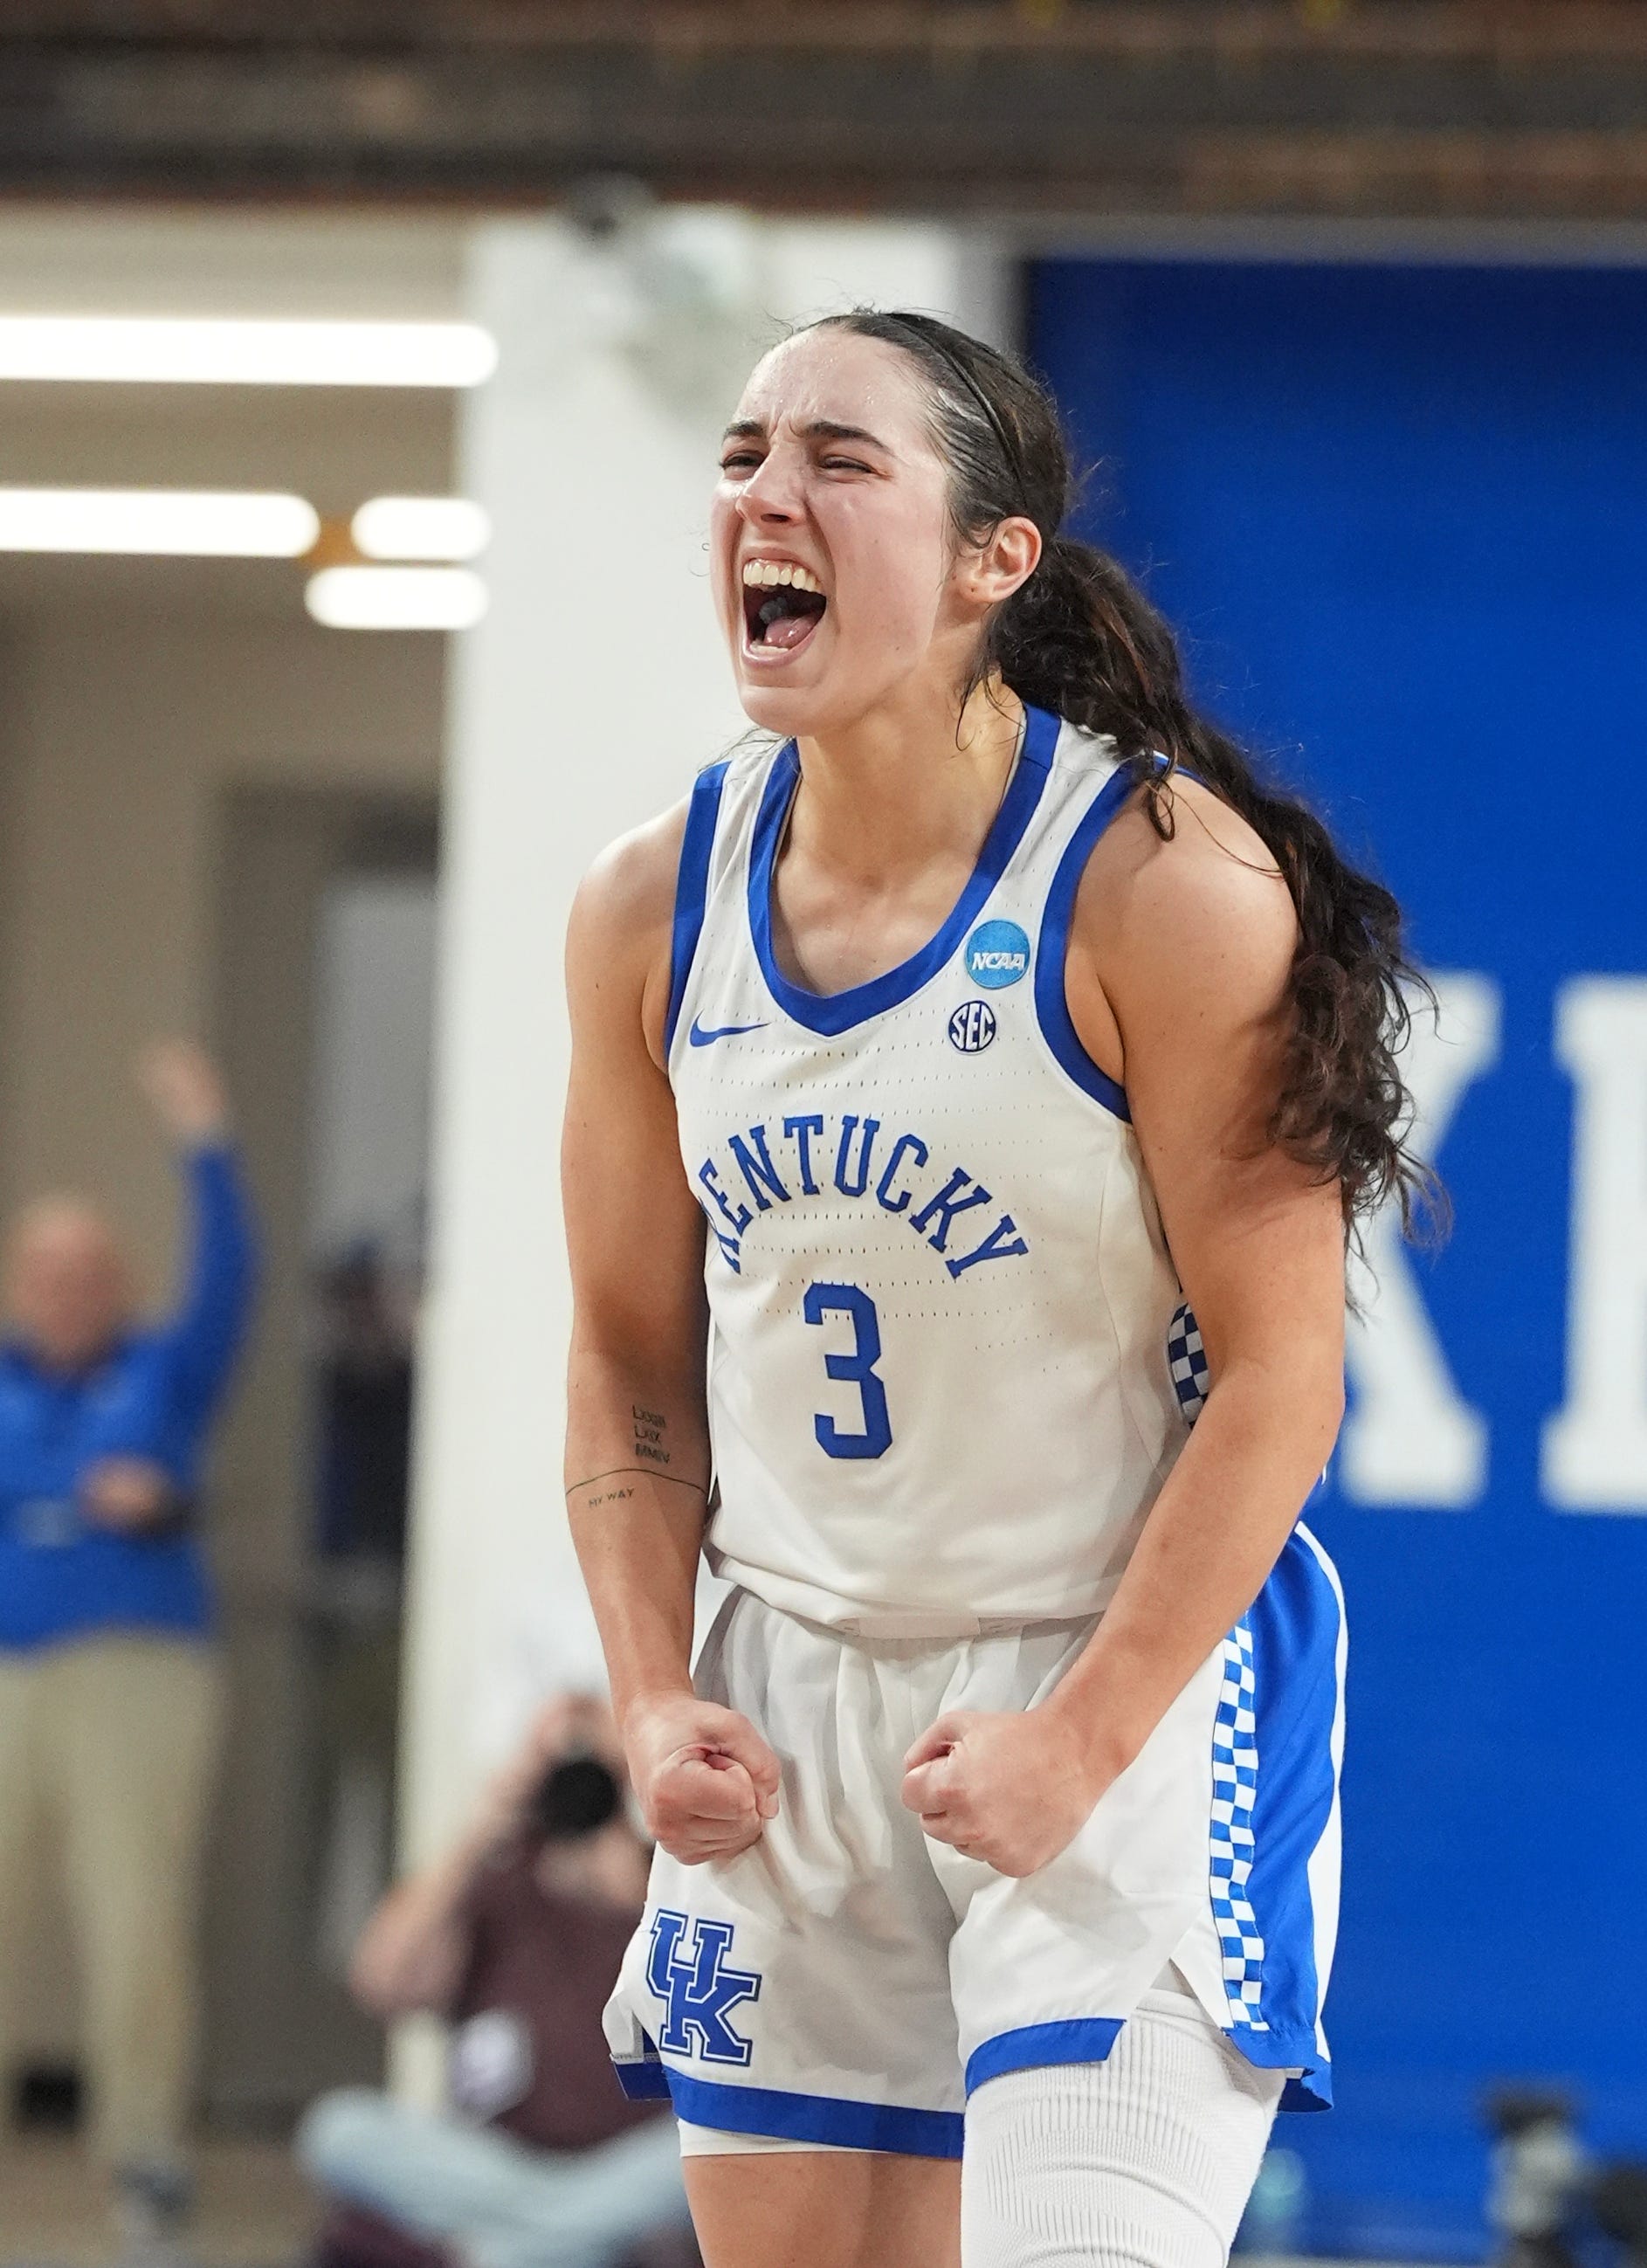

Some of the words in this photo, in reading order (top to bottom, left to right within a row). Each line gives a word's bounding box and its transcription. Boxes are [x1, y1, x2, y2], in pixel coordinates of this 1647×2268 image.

[972, 952, 1025, 970] NCAA
[950, 1003, 995, 1051] SEC
[803, 1282, 893, 1459] 3
[607, 1488, 635, 1501] WAY
[646, 1908, 762, 2067] UK
